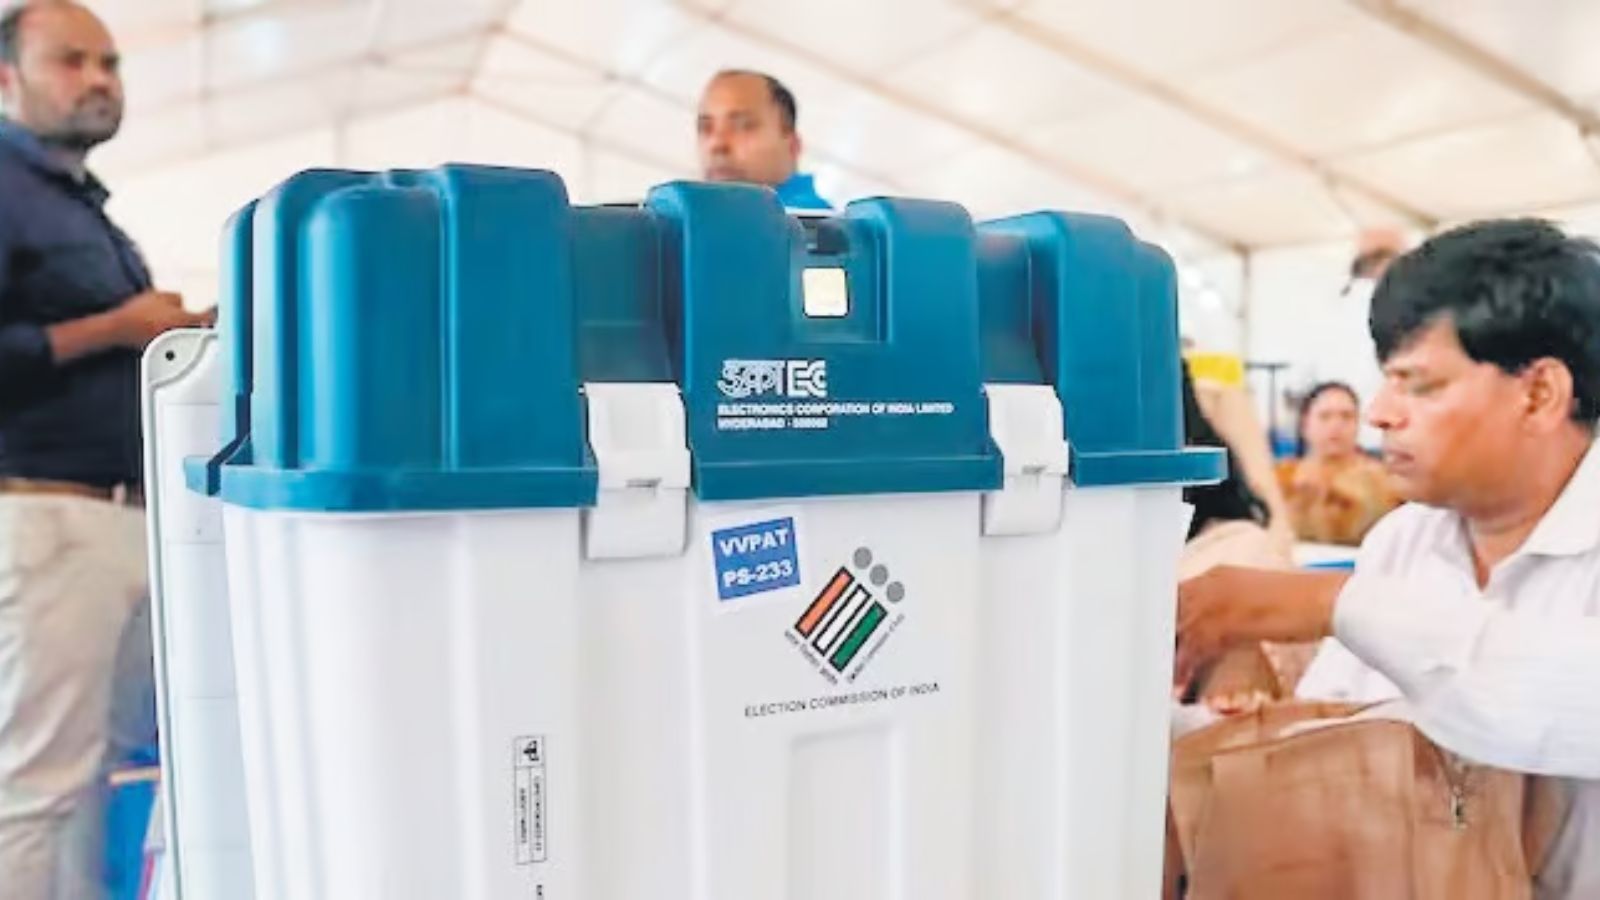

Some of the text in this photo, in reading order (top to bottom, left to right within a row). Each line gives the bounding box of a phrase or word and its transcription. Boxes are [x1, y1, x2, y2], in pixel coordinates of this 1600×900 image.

[718, 403, 954, 415] ELECTRONICS CORPORATION OF INDIA LIMITED
[720, 528, 789, 556] VVPAT
[722, 560, 794, 588] PS-233
[744, 682, 940, 718] ELECTION COMMISSION OF INDIA
